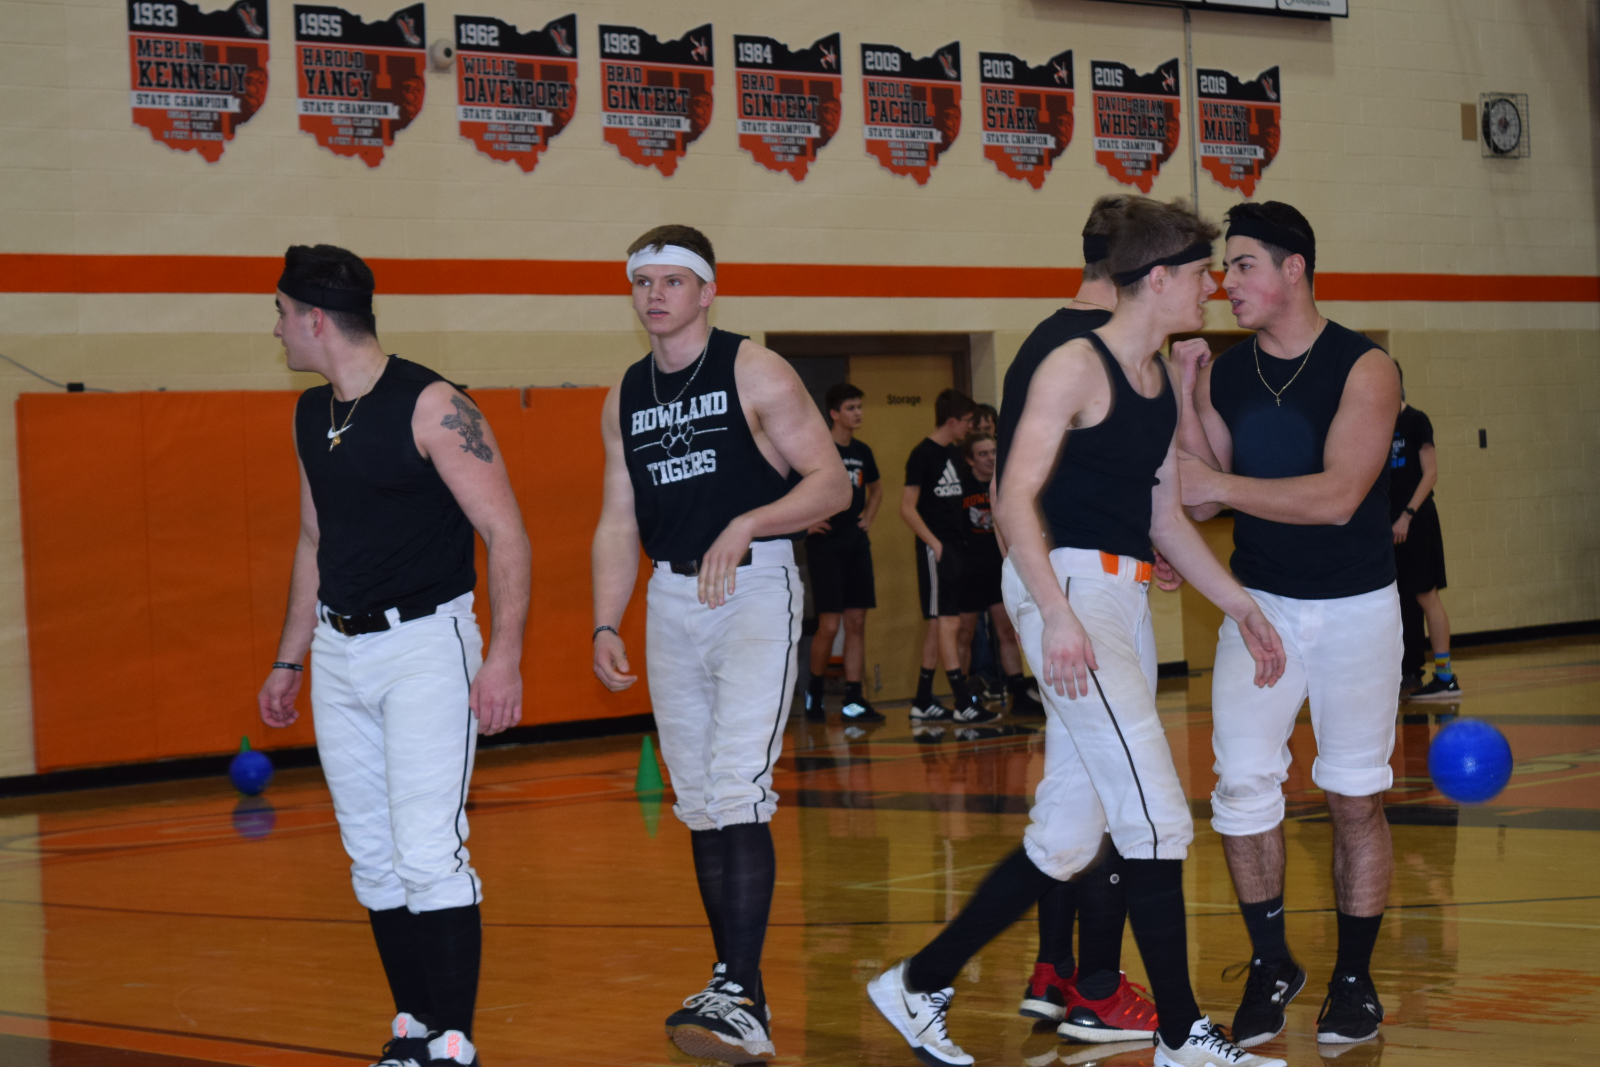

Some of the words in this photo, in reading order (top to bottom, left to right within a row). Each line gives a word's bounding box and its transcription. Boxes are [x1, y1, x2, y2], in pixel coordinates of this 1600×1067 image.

[133, 2, 178, 27] 1933
[299, 13, 342, 37] 1955
[460, 23, 499, 46] 1962
[603, 33, 641, 55] 1983
[136, 38, 203, 60] MERLIN
[302, 48, 365, 69] HAROLD
[738, 42, 773, 64] 1984
[462, 57, 516, 77] WILLIE
[865, 50, 901, 72] 2009
[983, 58, 1014, 80] 2013
[137, 60, 248, 93] KENNEDY
[304, 68, 372, 98] YANCY
[606, 65, 642, 83] BRAD
[740, 73, 775, 91] BRAD
[1094, 66, 1124, 87] 2015
[1200, 75, 1227, 94] 2019
[463, 77, 571, 109] DAVENPORT
[607, 84, 690, 113] GINTERT
[868, 81, 911, 99] NICOLE
[985, 88, 1016, 105] GABE
[136, 94, 170, 106] STATE
[174, 95, 229, 109] CHAMPION
[302, 101, 334, 112] STATE
[338, 102, 389, 115] CHAMPION
[742, 92, 819, 121] GINTERT
[1203, 103, 1246, 119] VINCENT
[462, 108, 492, 119] STATE
[495, 110, 543, 122] CHAMPION
[606, 114, 634, 125] STATE
[637, 116, 682, 128] CHAMPION
[868, 99, 933, 126] PACHOL
[986, 106, 1037, 131] STARK
[741, 122, 768, 133] STATE
[770, 123, 811, 135] CHAMPION
[868, 127, 893, 138] STATE
[894, 128, 934, 140] CHAMPION
[1098, 113, 1166, 138] WHISLER
[1203, 119, 1248, 142] MAURI
[986, 133, 1010, 144] STATE
[1011, 134, 1048, 146] CHAMPION
[1097, 139, 1119, 149] STATE
[1121, 140, 1156, 151] CHAMPION
[1203, 144, 1224, 154] STATE
[1225, 145, 1258, 156] CHAMPION
[887, 394, 921, 406] Storage
[631, 390, 728, 436] HOWLAND
[646, 449, 716, 486] TIGERS
